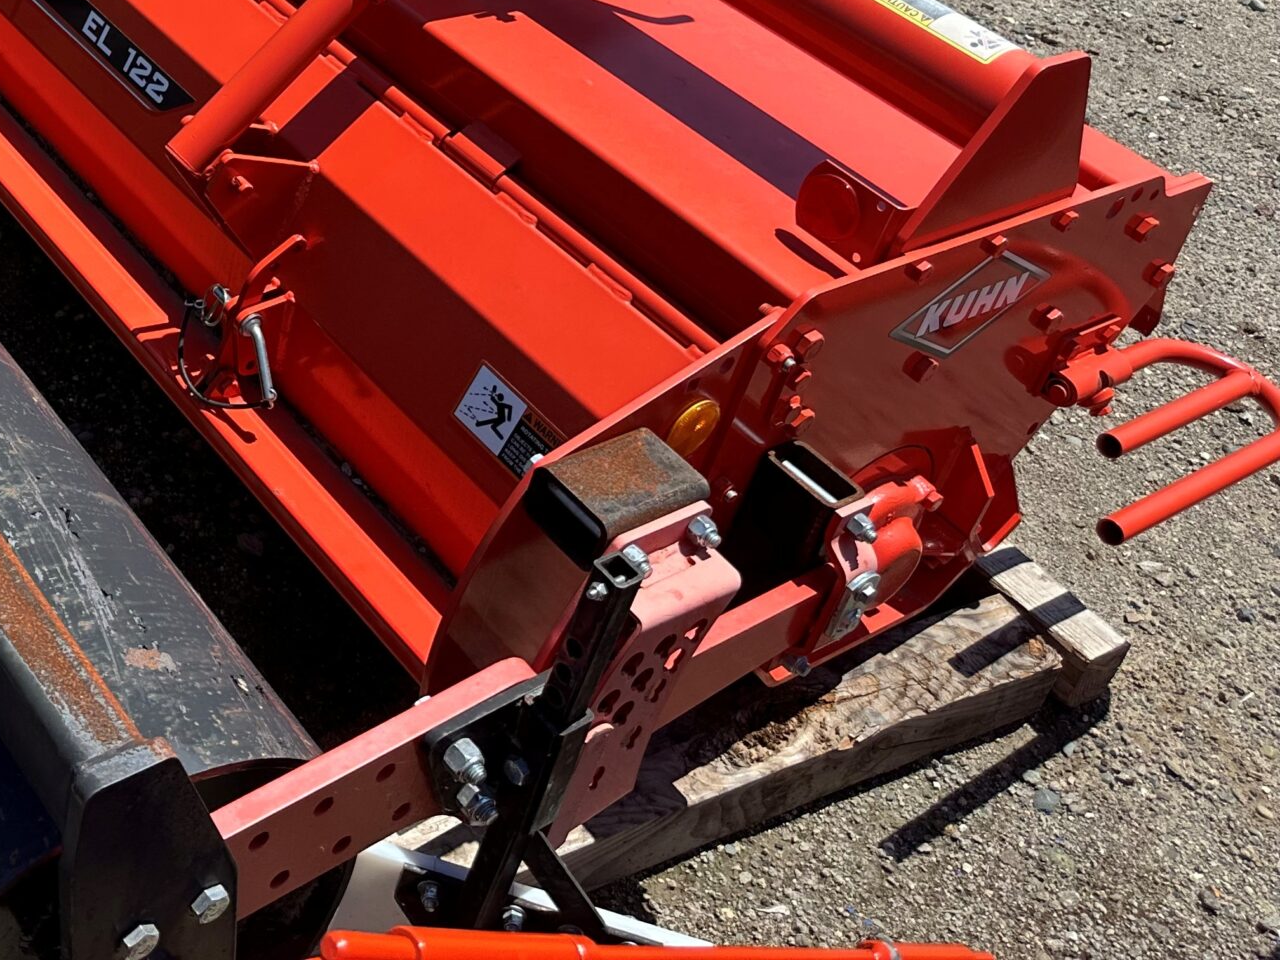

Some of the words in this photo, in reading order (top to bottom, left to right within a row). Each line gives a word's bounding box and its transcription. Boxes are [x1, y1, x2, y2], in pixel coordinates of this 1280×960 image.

[81, 9, 113, 57] EL
[122, 47, 170, 104] 122
[914, 271, 1031, 339] KUHN
[533, 418, 560, 448] WARN
